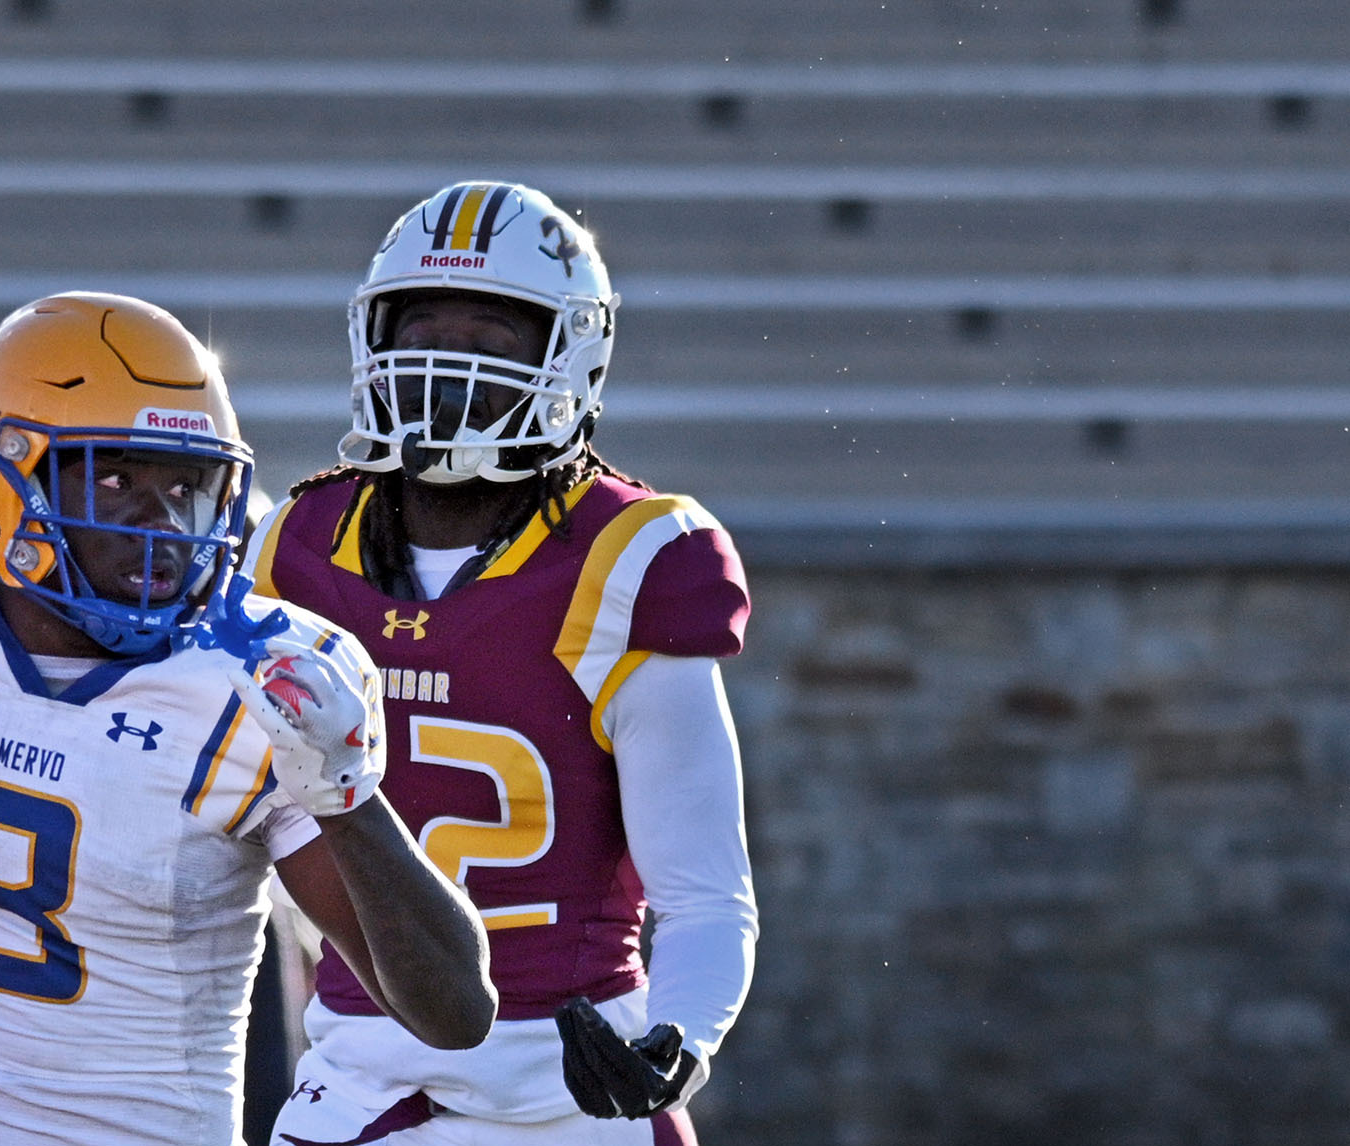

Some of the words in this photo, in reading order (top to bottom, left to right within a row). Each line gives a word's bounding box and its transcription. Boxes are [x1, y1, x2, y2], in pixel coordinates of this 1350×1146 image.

[419, 254, 486, 269] Riddell
[146, 411, 209, 431] Riddell
[193, 516, 228, 567] Ridell
